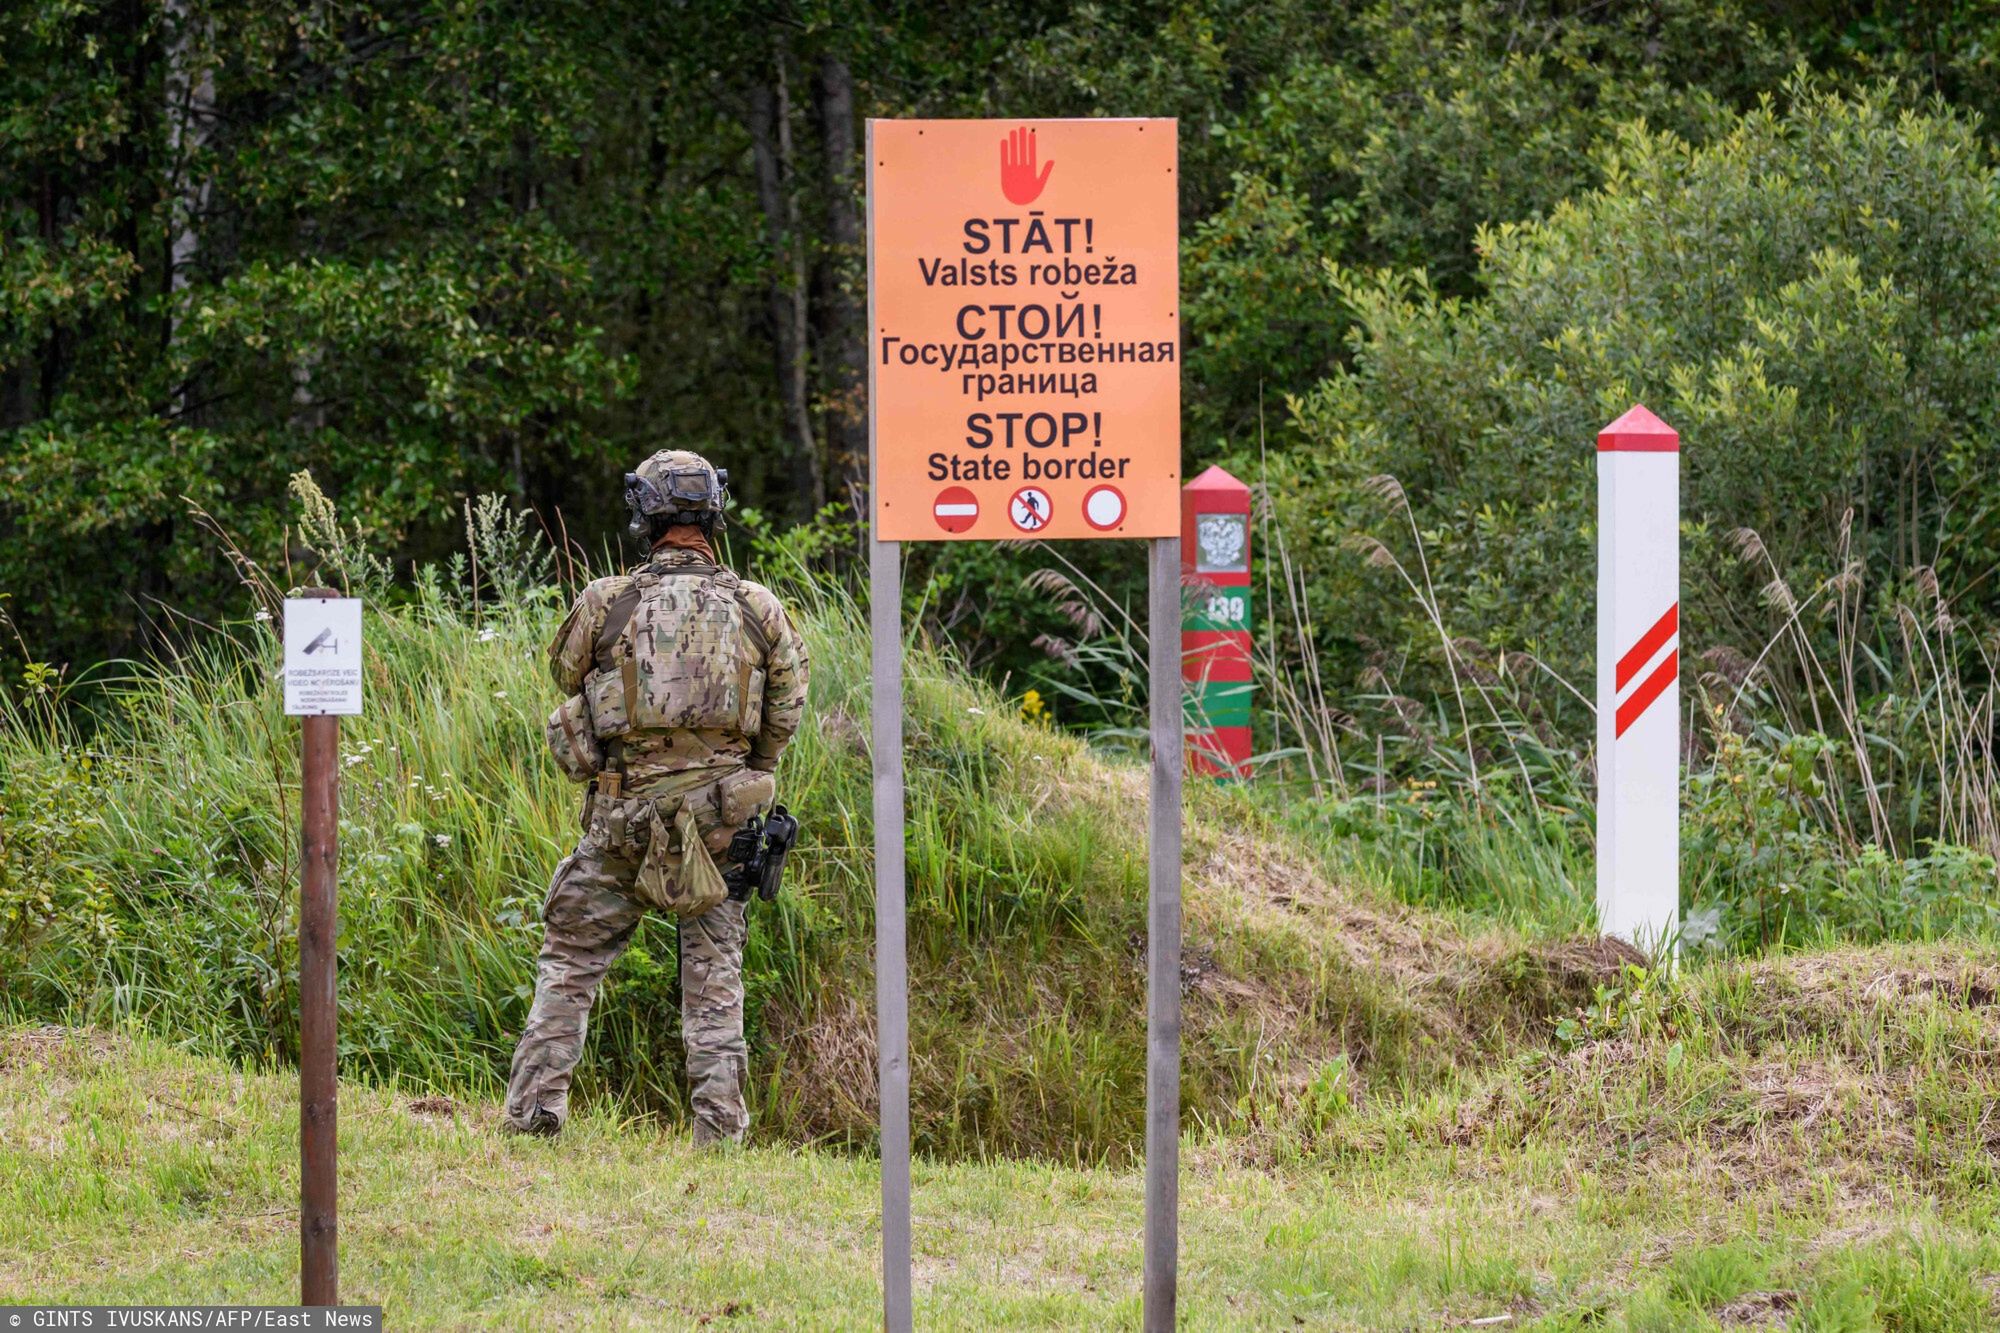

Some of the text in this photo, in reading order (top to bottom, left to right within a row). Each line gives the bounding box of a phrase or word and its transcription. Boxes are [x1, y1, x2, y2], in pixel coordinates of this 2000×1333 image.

[964, 211, 1093, 254] STĀT!
[919, 256, 1137, 286] Valsts robeža
[957, 291, 1101, 340] СТОЙ!
[882, 337, 1174, 371] Государственная
[963, 373, 1098, 402] граница
[966, 412, 1101, 449] STOP!
[928, 452, 1131, 482] State border
